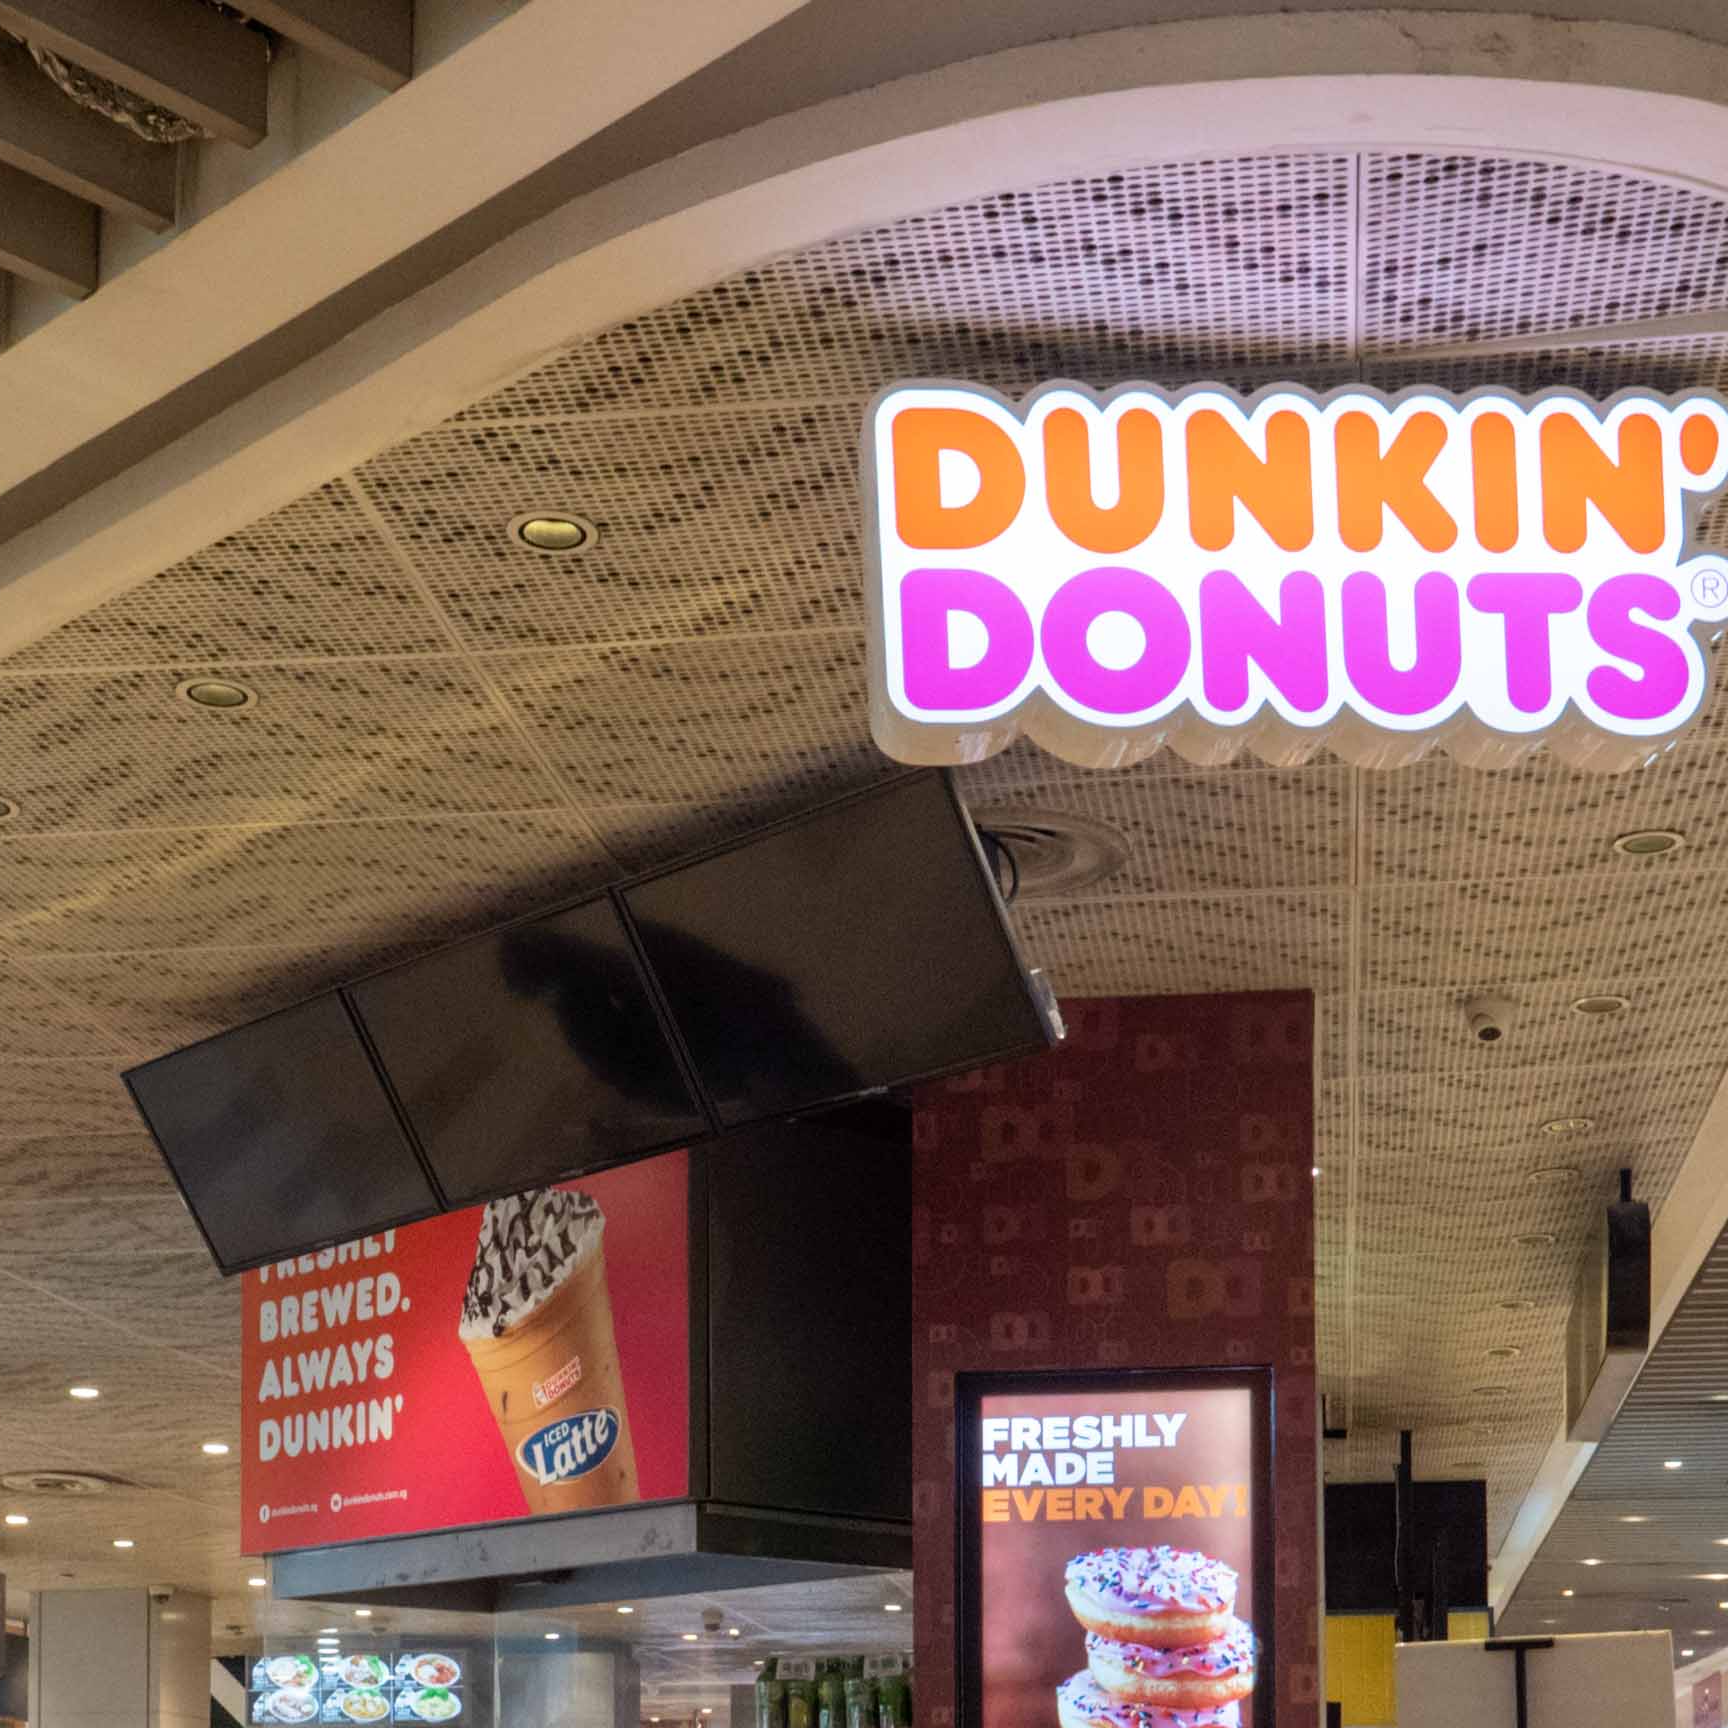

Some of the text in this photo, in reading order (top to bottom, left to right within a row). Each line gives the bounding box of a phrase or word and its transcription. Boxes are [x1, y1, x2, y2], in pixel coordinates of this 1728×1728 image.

[891, 406, 1720, 555] DUNKIN'
[899, 566, 1691, 722] DONUTS
[259, 1272, 411, 1343] BREWED.
[258, 1333, 395, 1404] ALWAYS
[258, 1394, 404, 1463] DUNKIN'
[532, 1409, 609, 1487] Latte
[543, 1422, 570, 1447] ICED
[982, 1413, 1188, 1451] FRESHLY
[982, 1451, 1115, 1487] MADE
[982, 1484, 1247, 1523] EVERY DAY!
